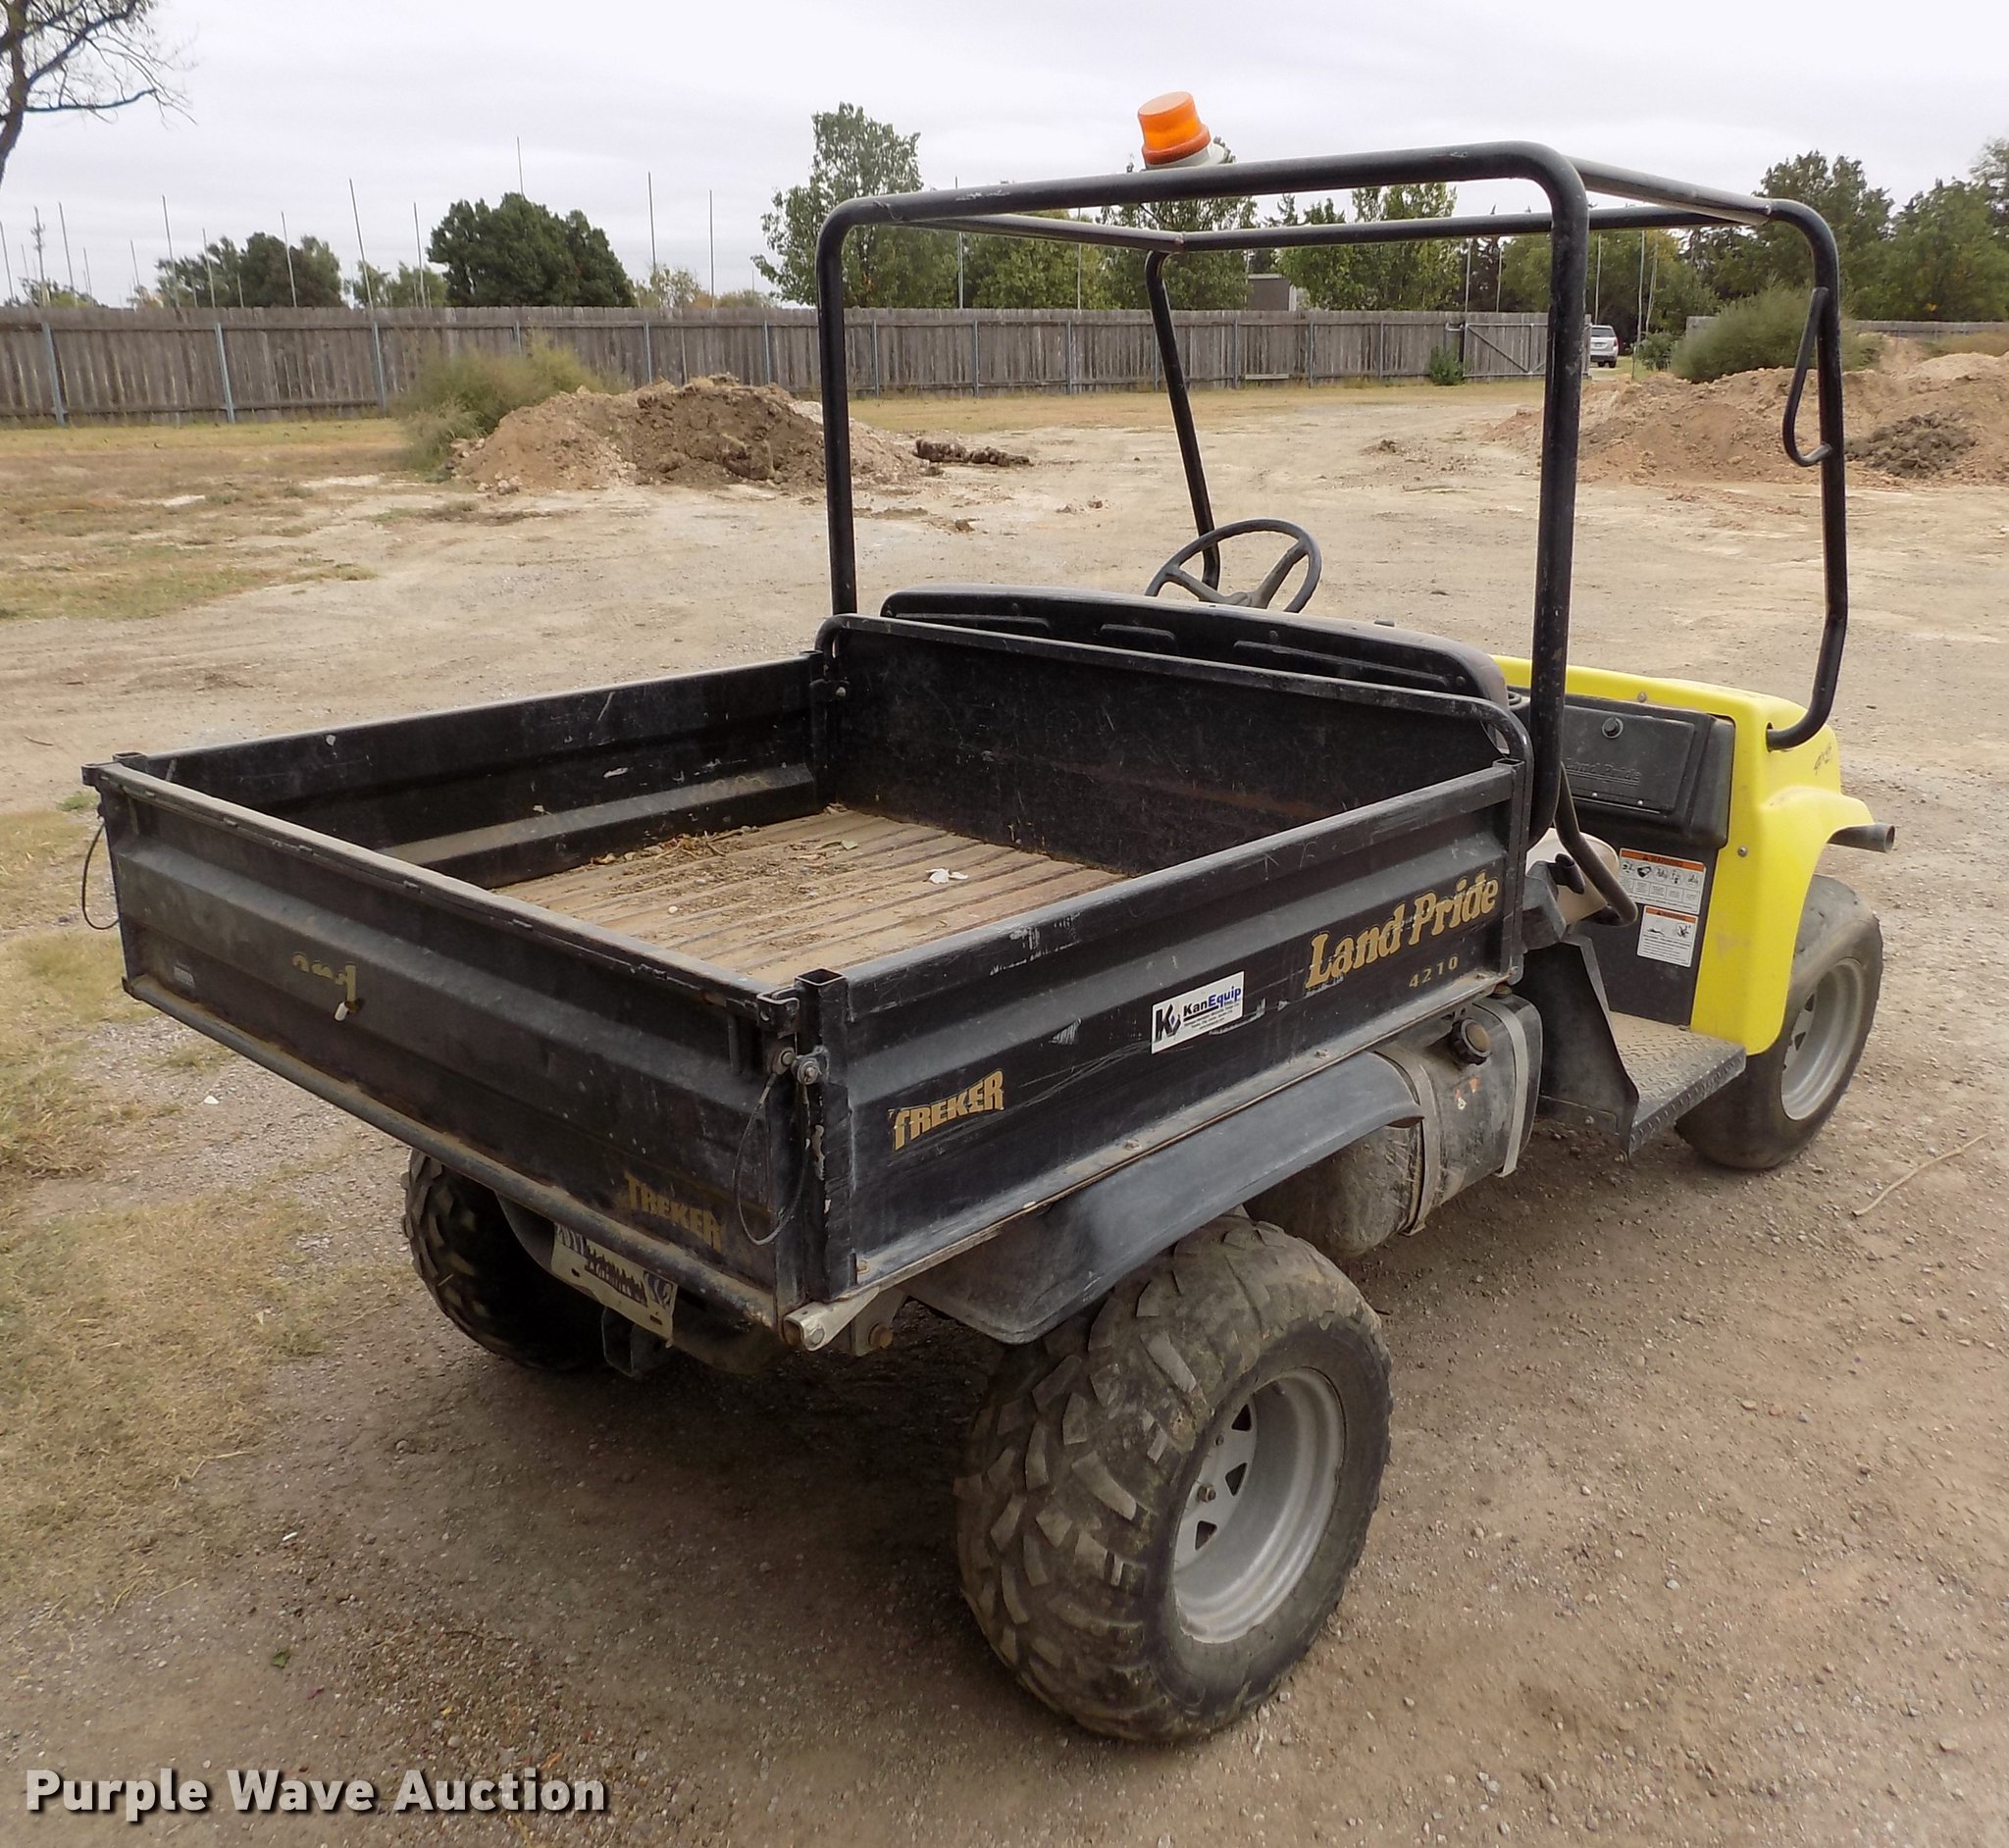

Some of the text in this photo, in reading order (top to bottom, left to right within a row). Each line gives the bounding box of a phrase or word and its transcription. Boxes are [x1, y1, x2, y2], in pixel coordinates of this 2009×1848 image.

[1305, 870, 1499, 989] Land Pride
[1183, 986, 1242, 1017] KanEquip
[1409, 955, 1460, 989] 4210
[888, 1069, 1004, 1152] TREKER
[624, 1170, 724, 1253] TREKER
